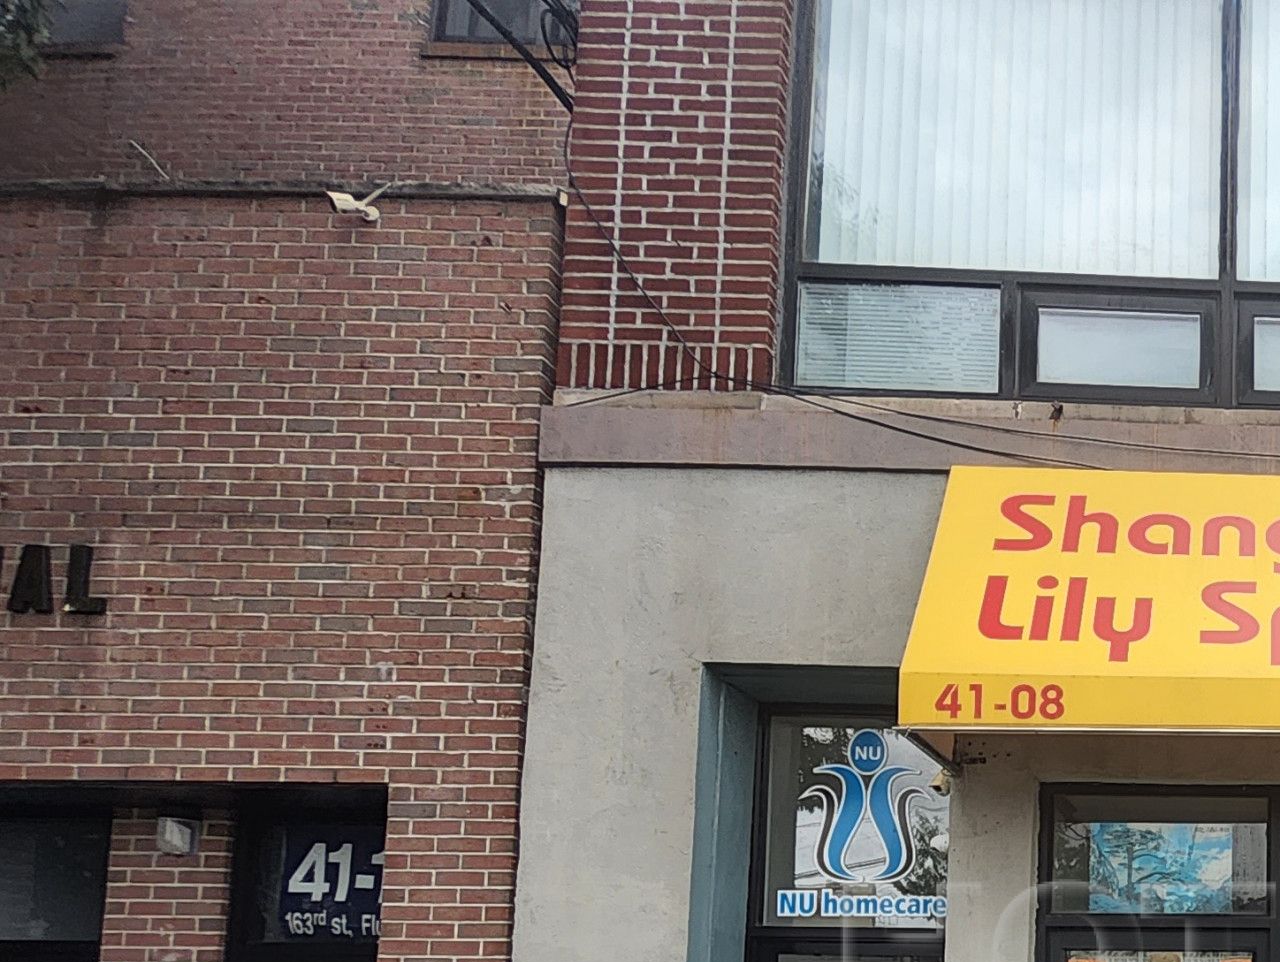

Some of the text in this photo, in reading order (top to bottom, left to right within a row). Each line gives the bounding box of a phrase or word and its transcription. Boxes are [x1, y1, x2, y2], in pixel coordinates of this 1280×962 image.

[0, 544, 107, 615] AL
[977, 575, 1154, 663] Lily
[934, 683, 1065, 720] 41-08
[854, 745, 881, 761] NU
[778, 889, 948, 917] NU homecare
